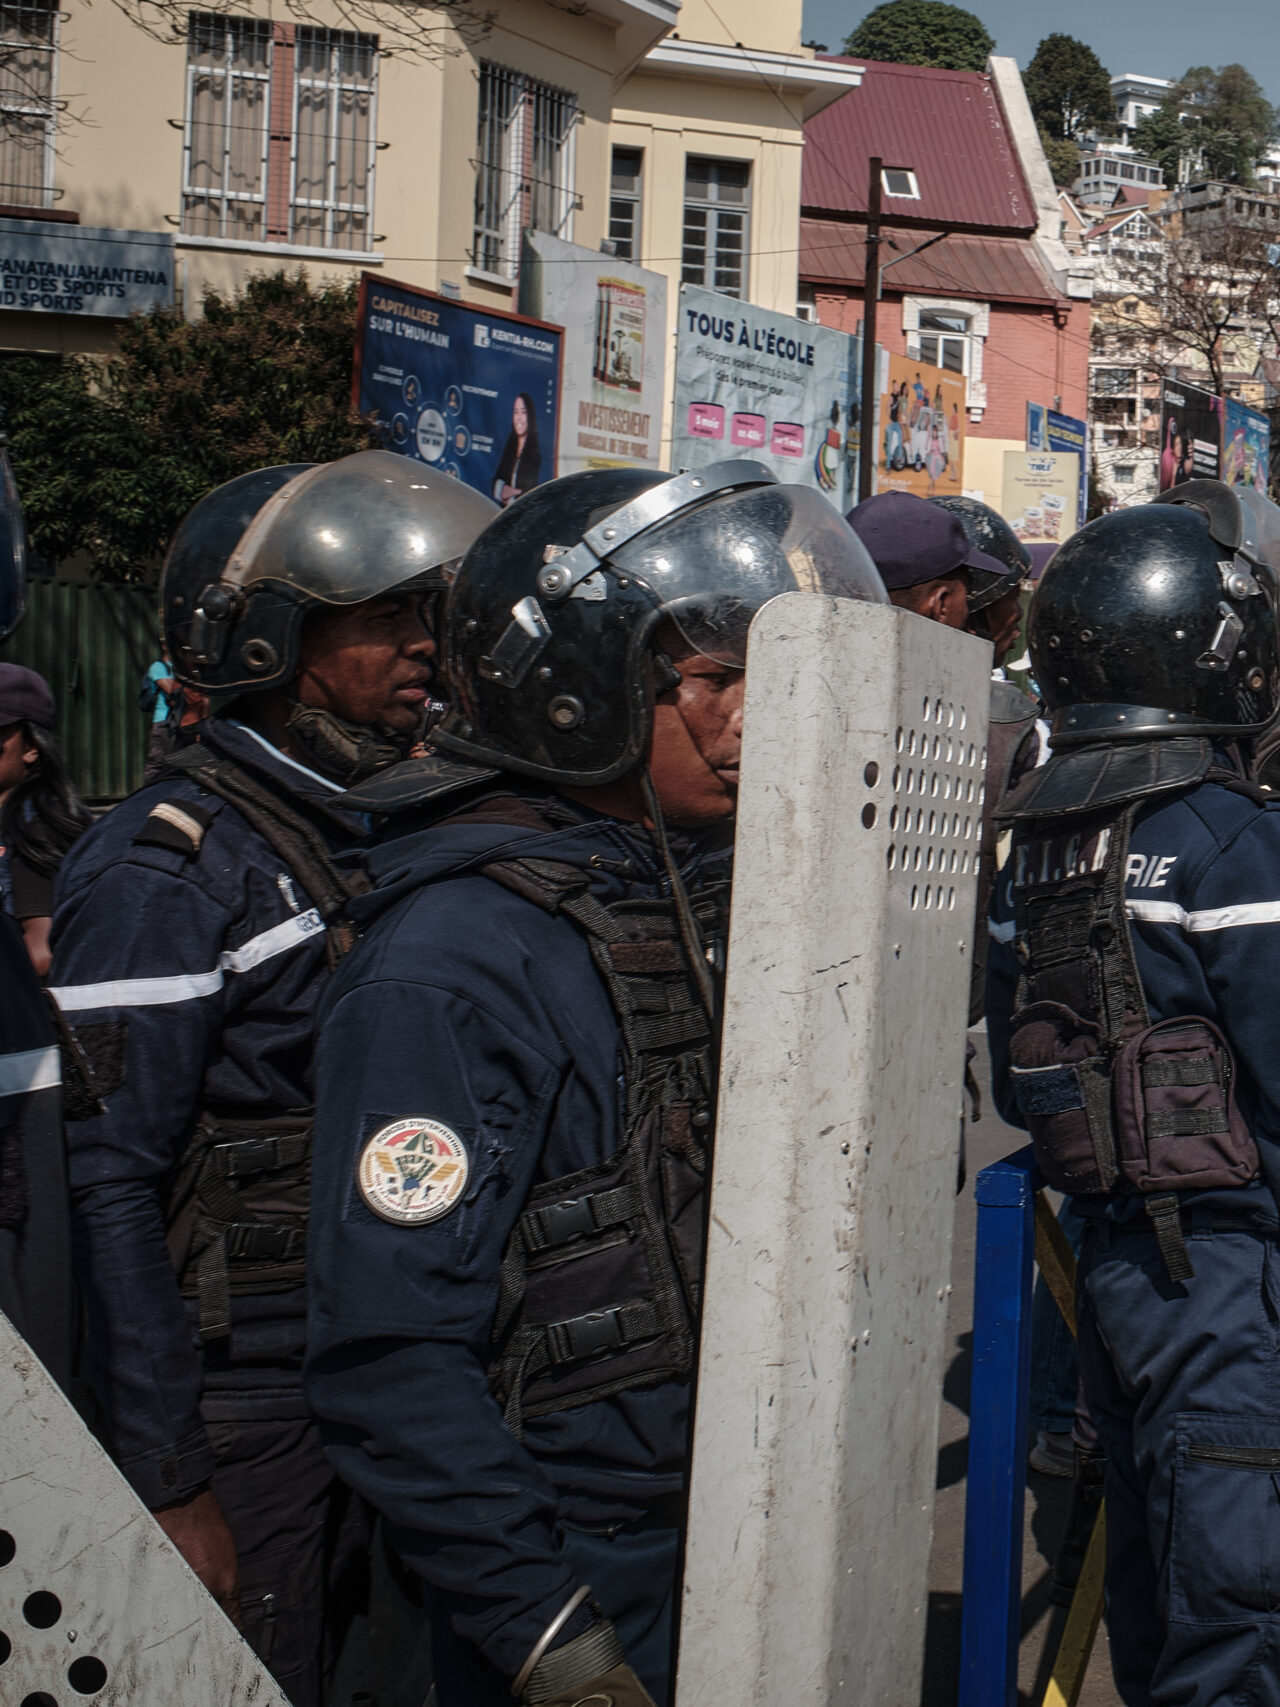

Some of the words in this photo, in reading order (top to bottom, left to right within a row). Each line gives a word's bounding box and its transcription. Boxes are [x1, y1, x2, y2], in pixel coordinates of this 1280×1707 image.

[0, 291, 16, 306] D
[19, 292, 84, 311] SPORTS
[3, 274, 23, 290] ET
[27, 276, 58, 293] DES
[62, 279, 126, 298] SPORTS
[371, 295, 440, 327] CAPITALISEZ
[369, 315, 393, 334] SUR
[395, 321, 450, 349] L'HUMAIN
[687, 309, 735, 343] TOUS
[738, 318, 750, 349] À
[754, 327, 815, 367] L'ÉCOLE
